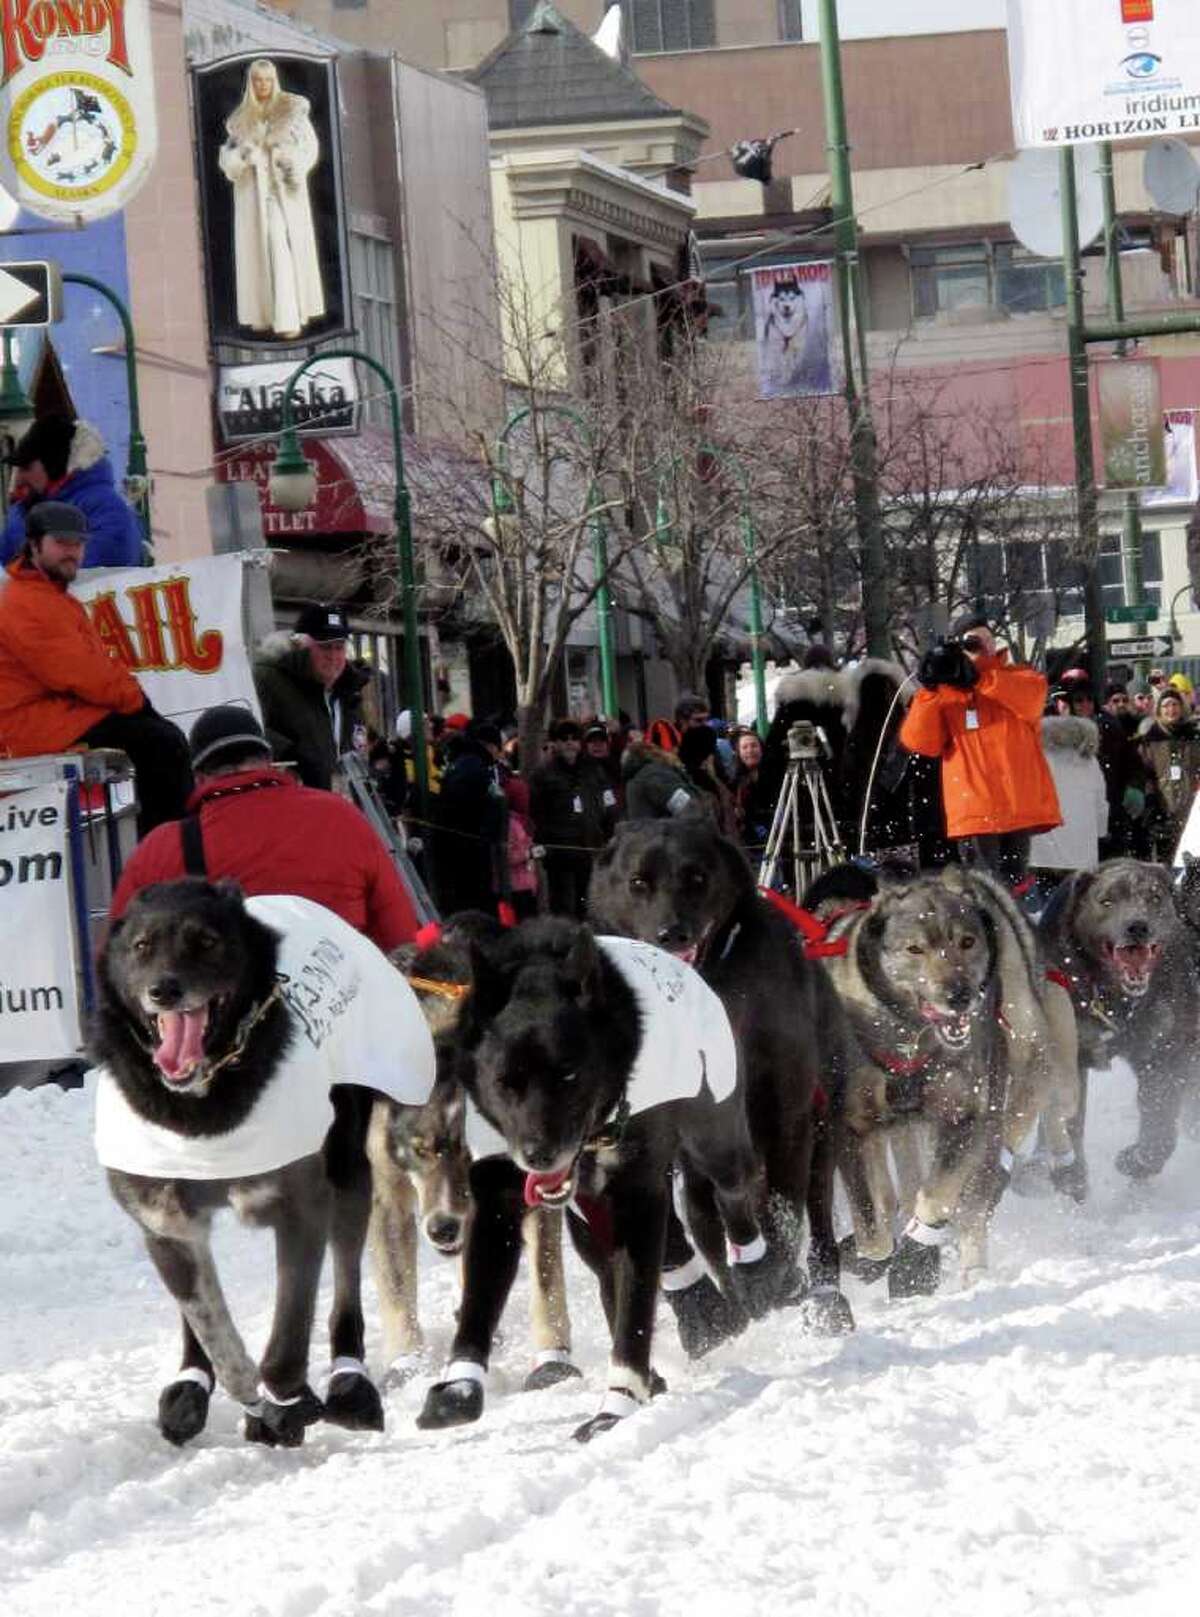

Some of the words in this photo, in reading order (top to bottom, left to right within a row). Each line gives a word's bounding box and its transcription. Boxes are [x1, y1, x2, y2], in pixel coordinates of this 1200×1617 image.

[1065, 116, 1167, 139] HORIZON
[1179, 114, 1200, 127] LI
[240, 381, 346, 411] Alaska
[265, 511, 316, 531] TLET
[88, 576, 223, 674] AIL
[0, 851, 62, 887] om
[0, 981, 63, 1013] ium
